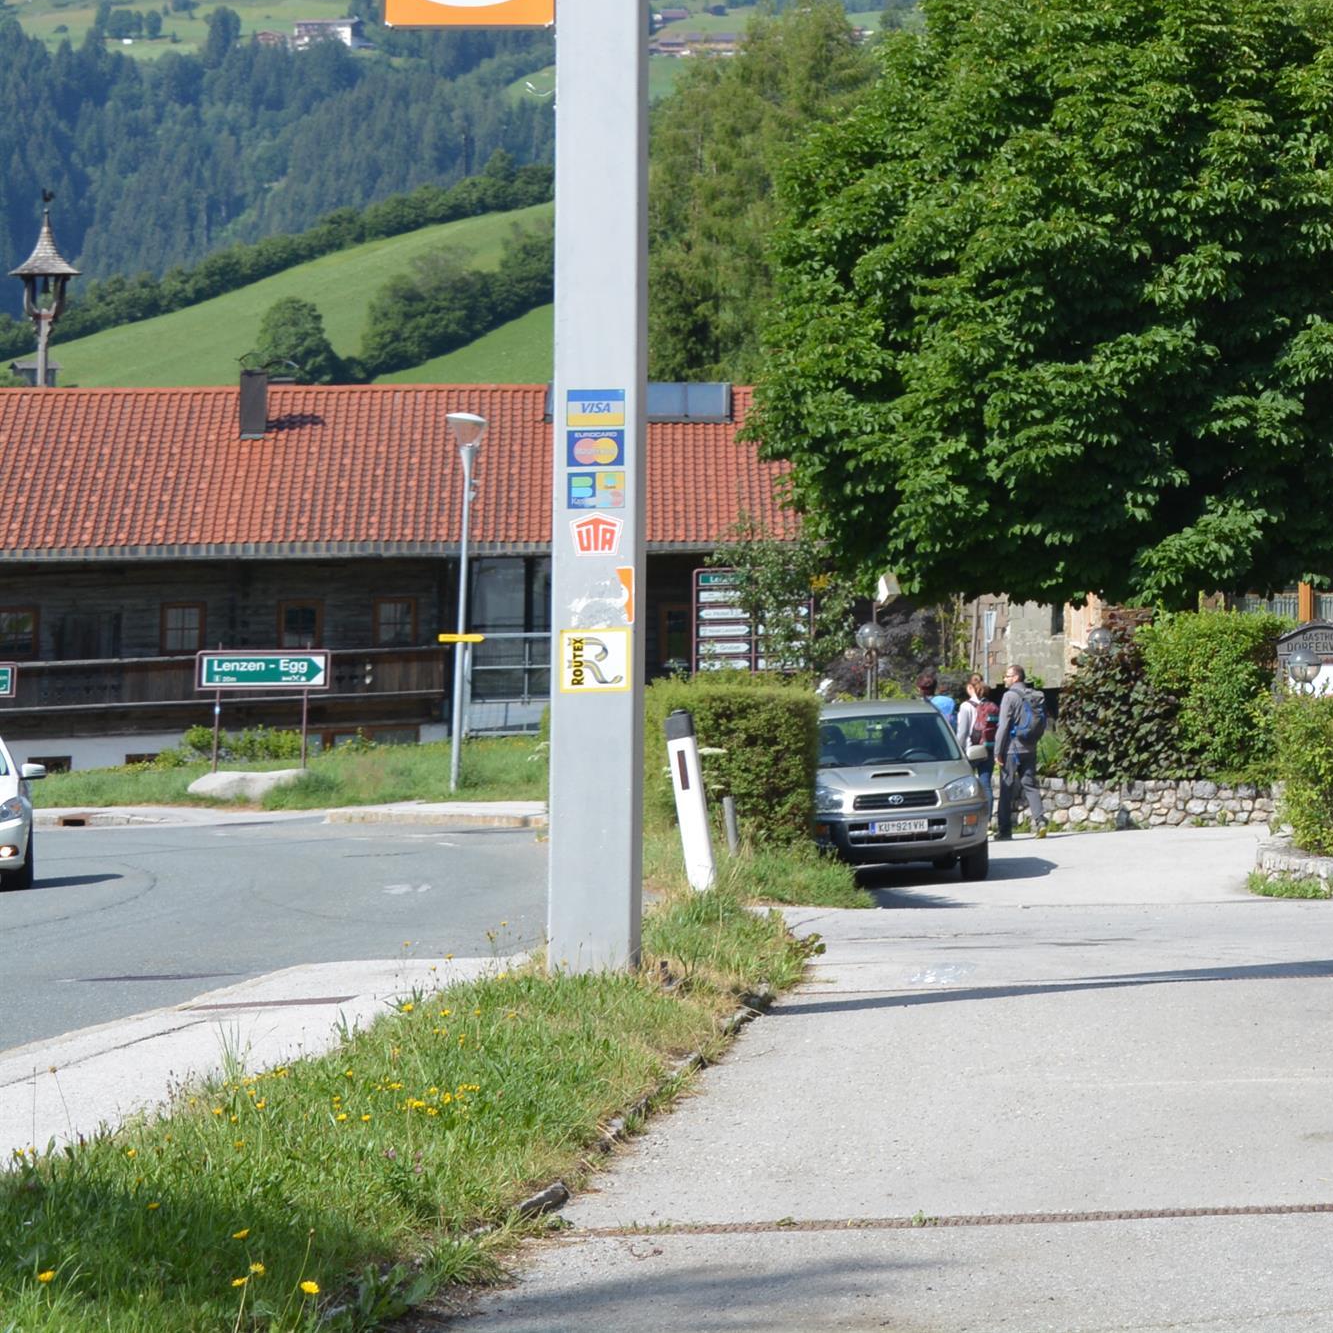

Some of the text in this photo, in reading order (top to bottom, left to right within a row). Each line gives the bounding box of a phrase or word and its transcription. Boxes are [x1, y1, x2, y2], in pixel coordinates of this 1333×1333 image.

[580, 402, 612, 414] VISA
[575, 517, 618, 552] UTA
[213, 659, 266, 671] Lenzen
[279, 659, 309, 673] Egg
[571, 638, 584, 686] ROUTEX
